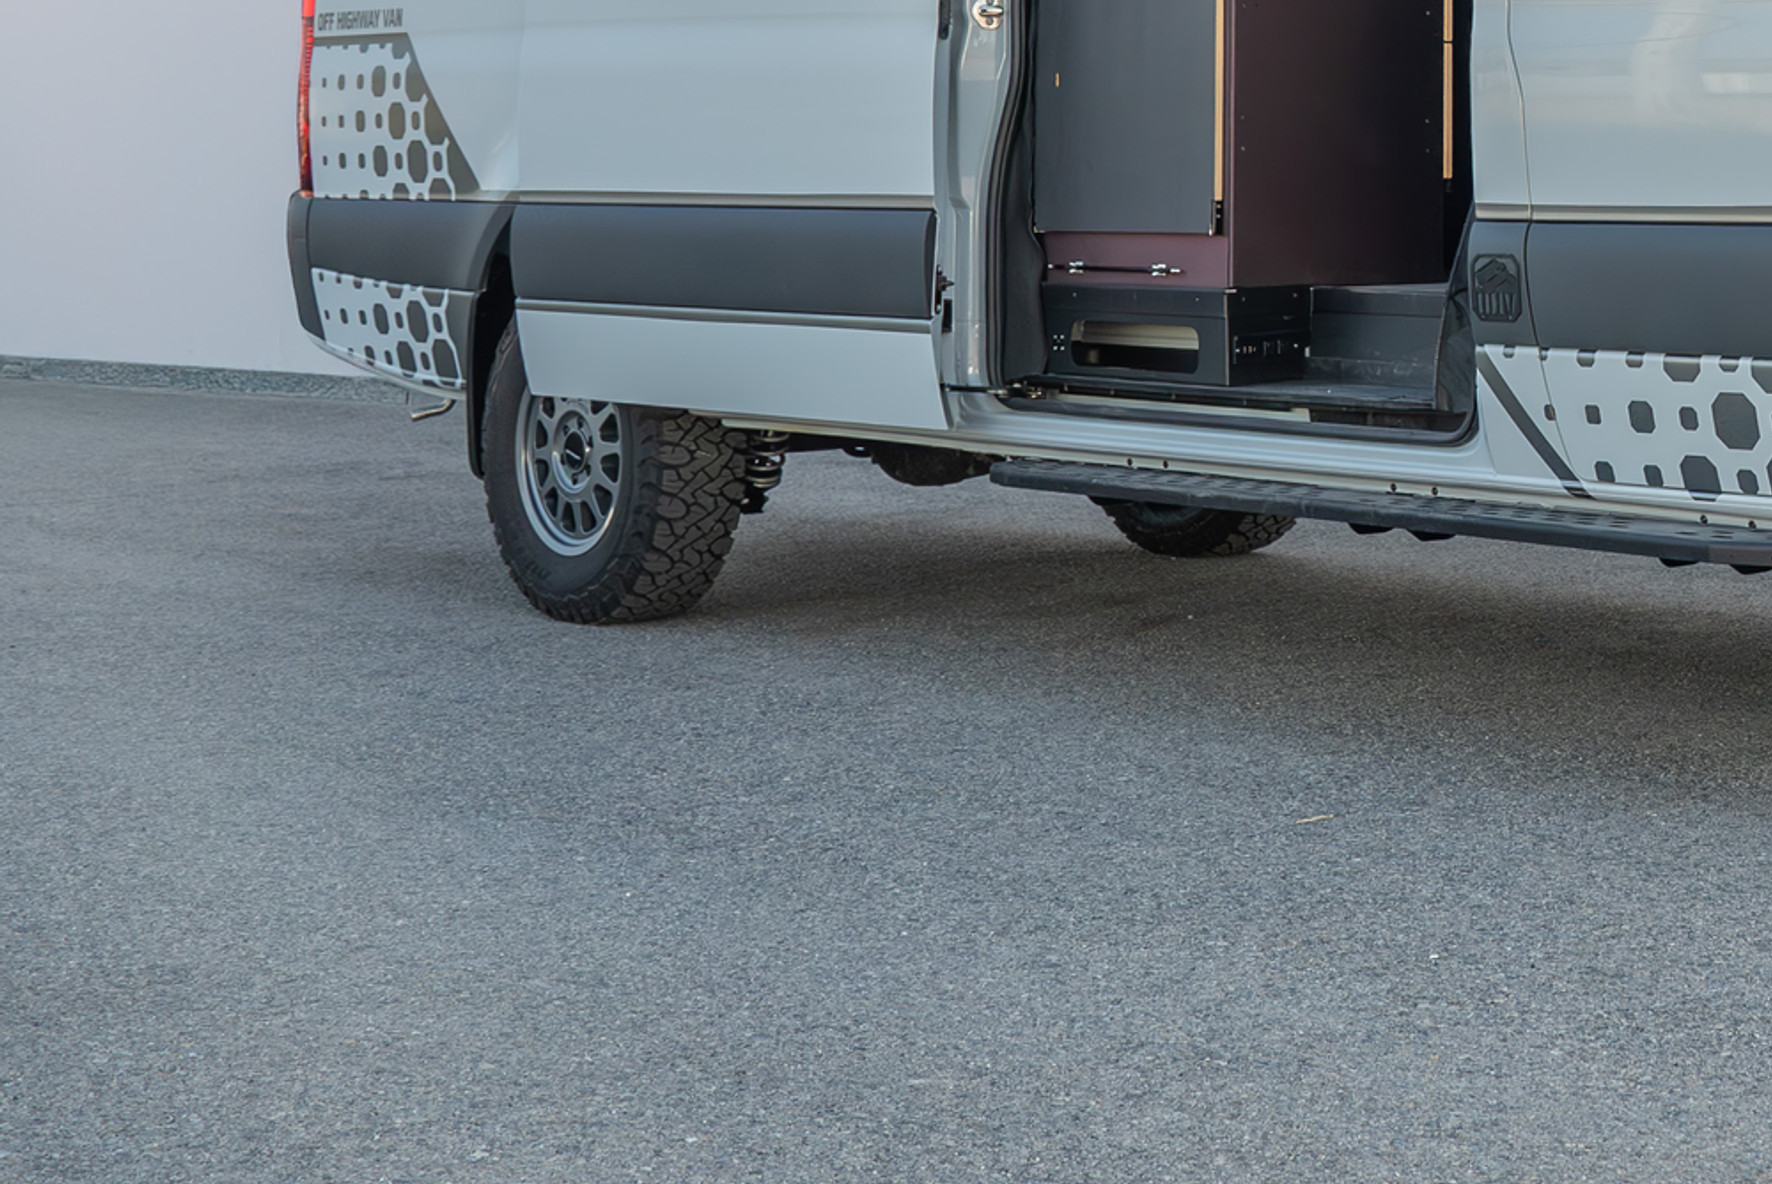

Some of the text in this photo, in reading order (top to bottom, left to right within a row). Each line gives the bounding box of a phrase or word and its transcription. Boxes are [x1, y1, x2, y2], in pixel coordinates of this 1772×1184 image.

[318, 7, 403, 31] OFF HIGHWAY VAN
